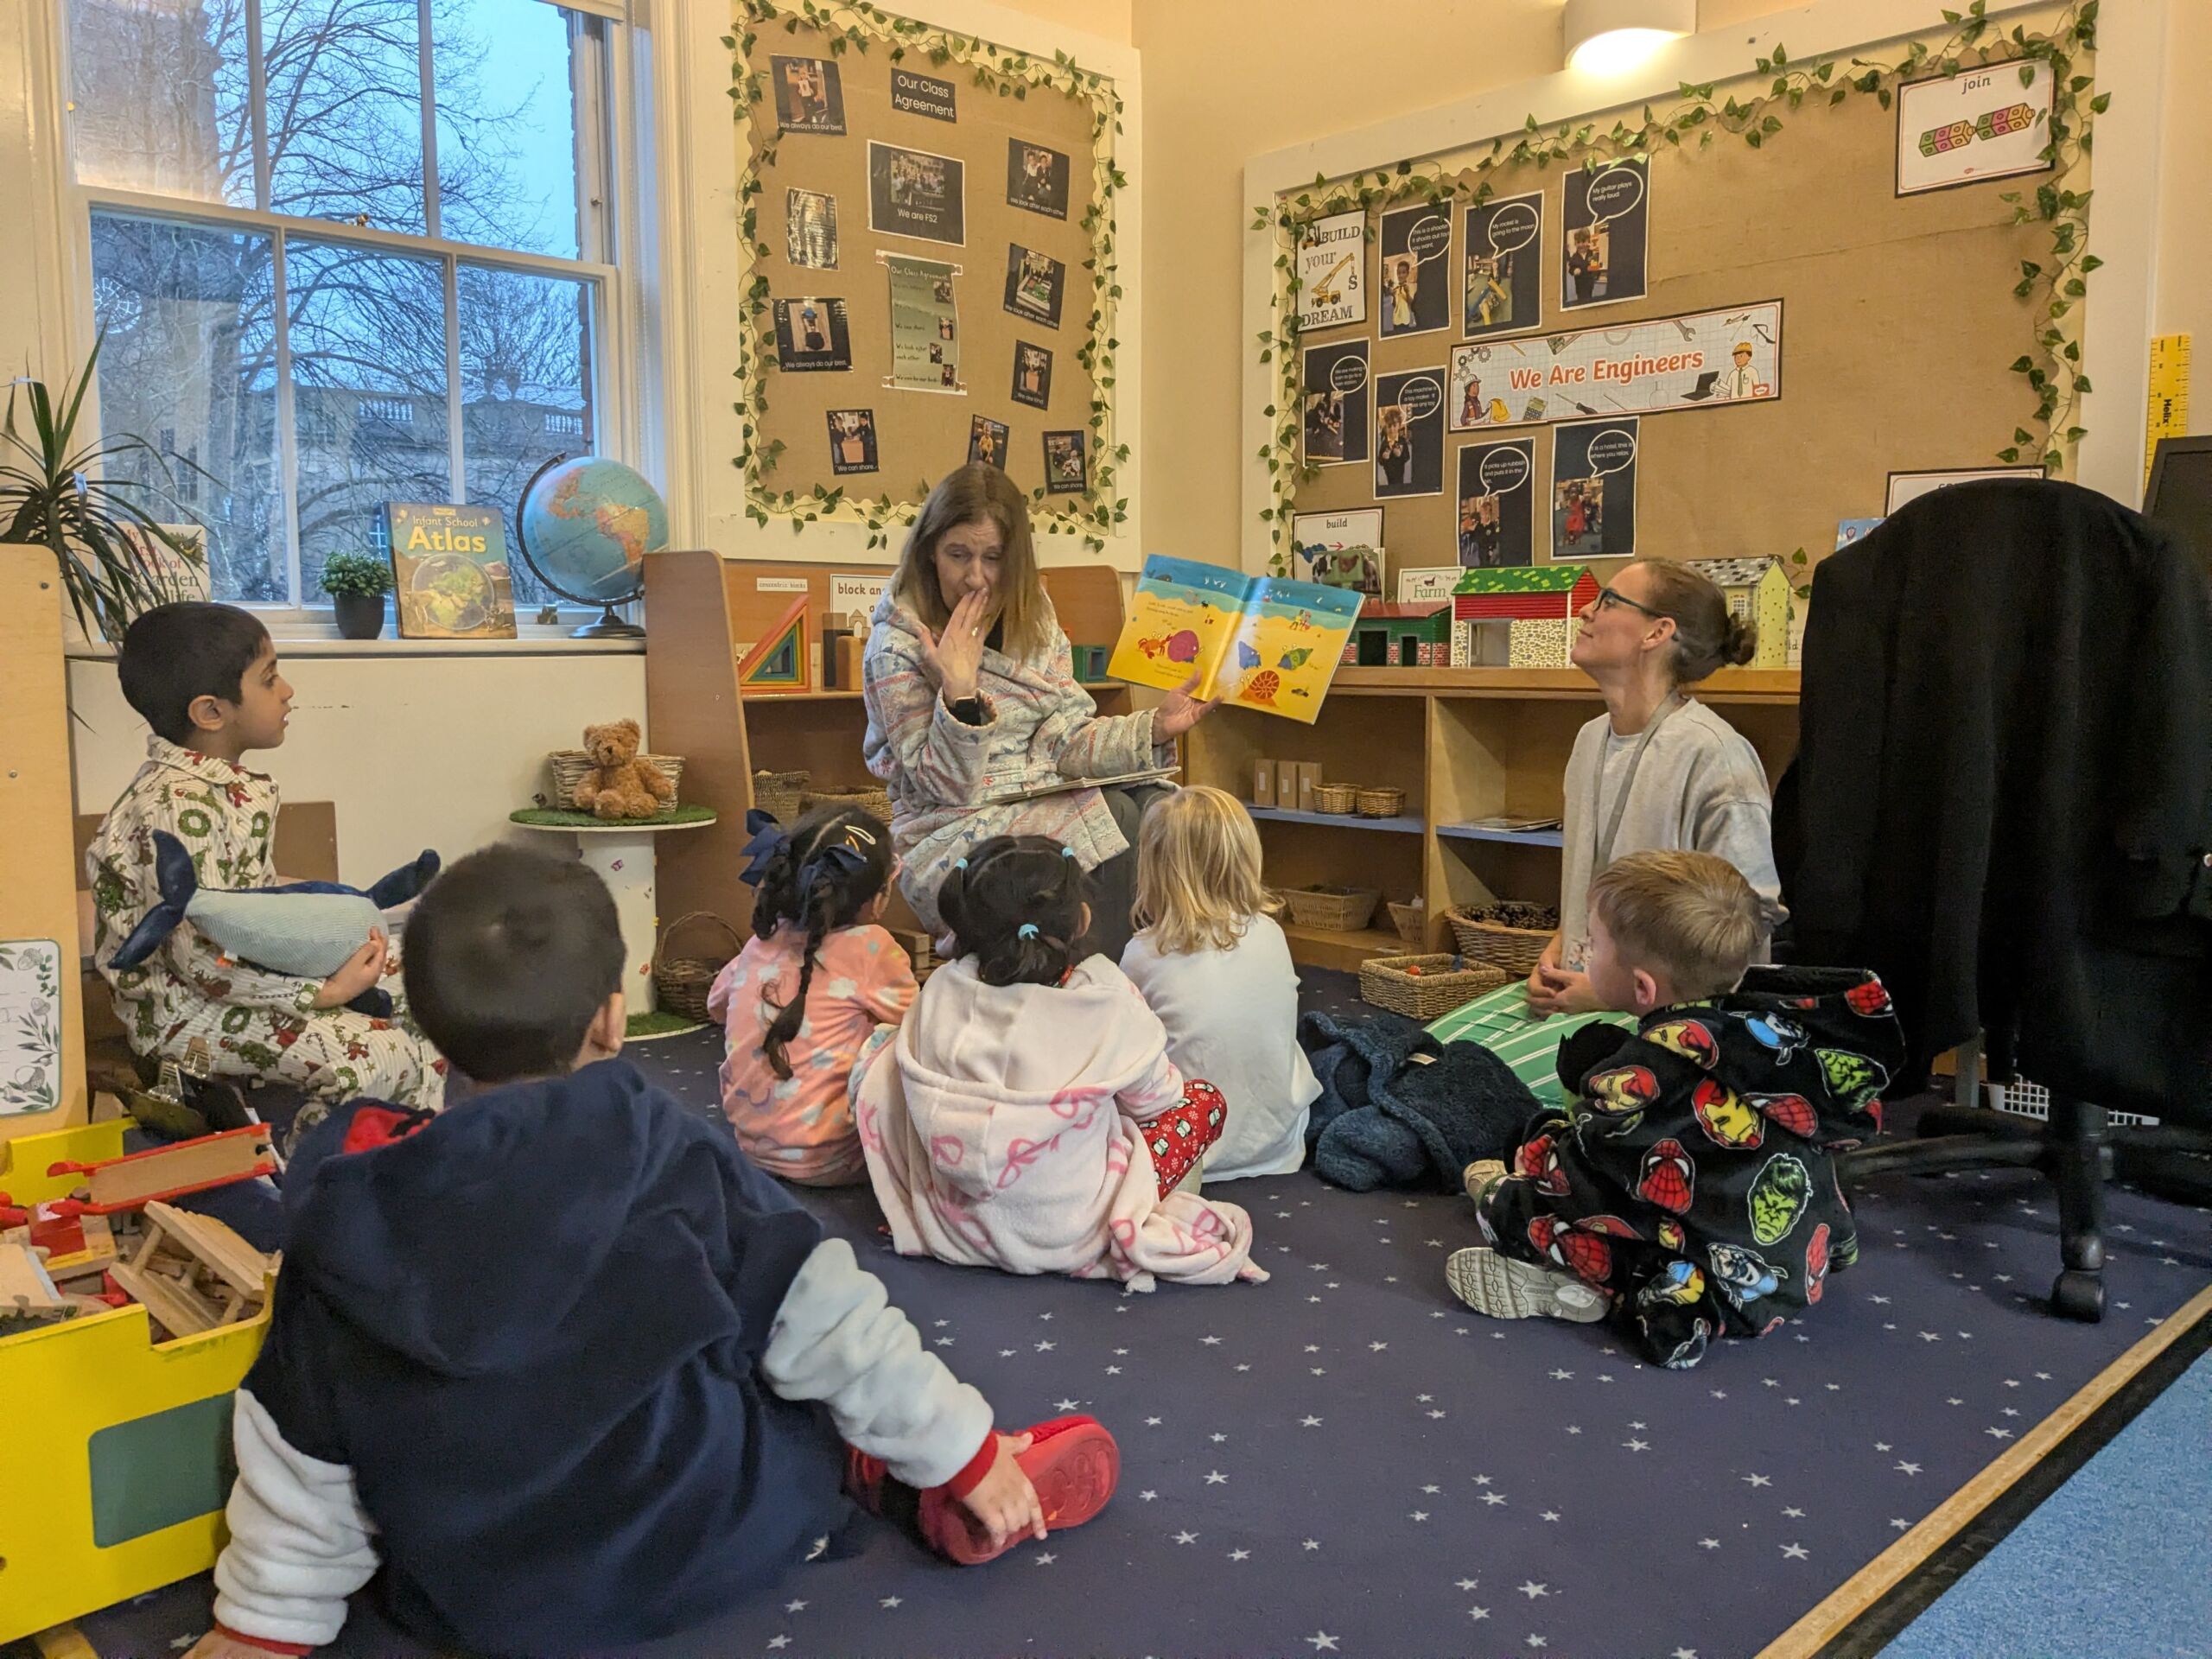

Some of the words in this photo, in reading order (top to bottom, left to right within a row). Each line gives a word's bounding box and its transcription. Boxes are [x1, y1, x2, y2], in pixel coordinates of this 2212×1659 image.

[897, 75, 917, 89] Our
[920, 80, 949, 98] Class
[1961, 75, 1991, 95] join
[895, 93, 955, 118] Agreement
[790, 122, 811, 131] always
[1600, 185, 1617, 194] guitar
[1617, 181, 1632, 190] plays
[897, 208, 910, 219] We
[911, 212, 924, 220] are
[925, 212, 938, 223] FS2
[1320, 226, 1361, 245] BUILD
[1305, 251, 1337, 274] your
[1348, 275, 1358, 290] S
[1302, 305, 1353, 327] DREAM
[796, 361, 815, 370] always
[1510, 369, 1541, 389] We
[1549, 364, 1586, 385] Are
[1593, 351, 1703, 385] Engineers
[2163, 399, 2172, 424] Helix
[413, 516, 442, 528] Infant
[445, 517, 478, 528] School
[1326, 518, 1348, 529] build
[408, 526, 486, 552] Atlas
[169, 558, 181, 569] of
[838, 582, 866, 595] block
[1414, 585, 1446, 599] Farm
